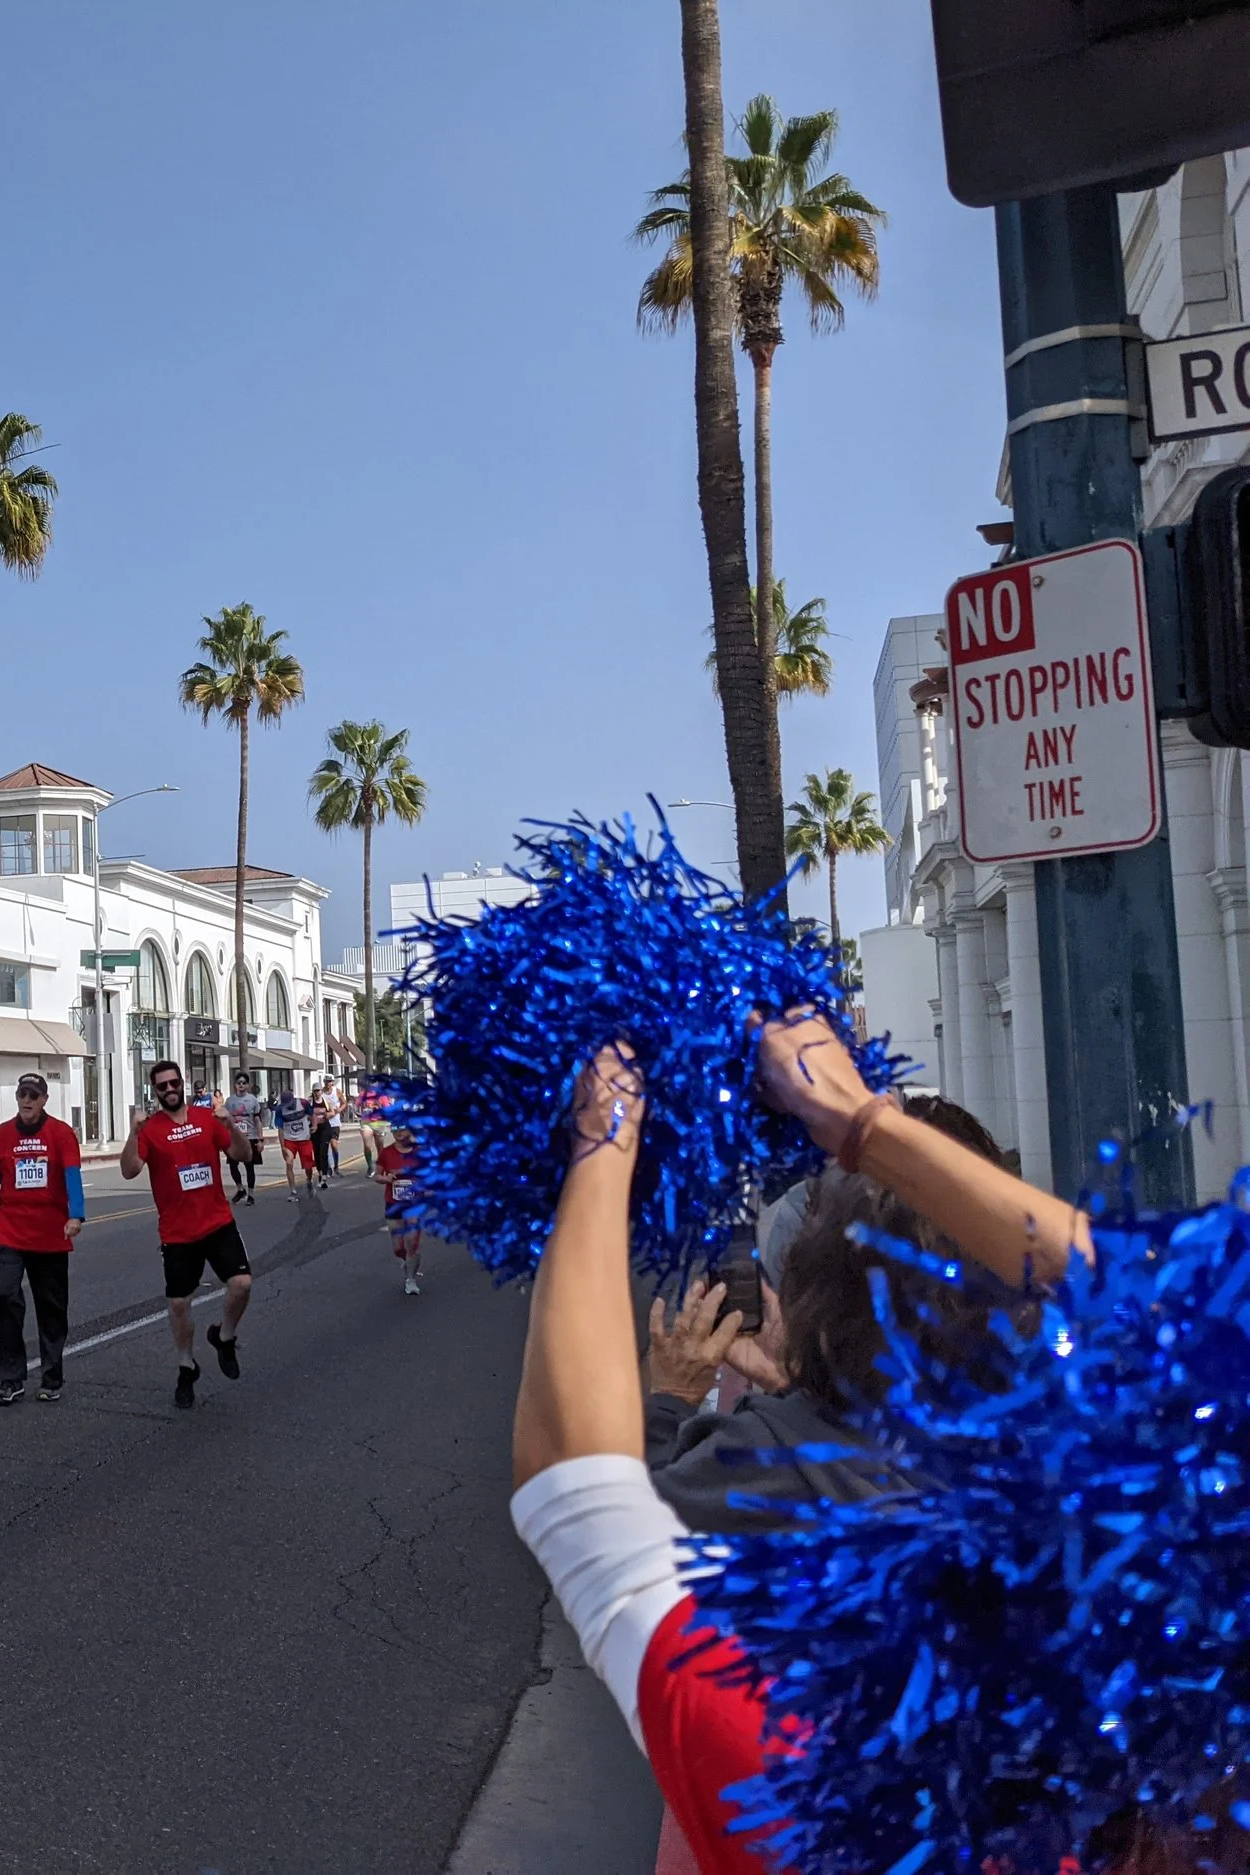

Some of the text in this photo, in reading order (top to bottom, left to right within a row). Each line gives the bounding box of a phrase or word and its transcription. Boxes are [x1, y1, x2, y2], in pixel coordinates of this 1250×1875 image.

[957, 579, 1021, 650] NO
[965, 647, 1134, 729] STOPPING
[1024, 724, 1077, 770] ANY
[1024, 776, 1085, 822] TIME
[167, 1127, 202, 1140] CONCERN
[172, 1124, 194, 1134] TEAM
[19, 1168, 44, 1179] 11018
[183, 1170, 210, 1183] COACH
